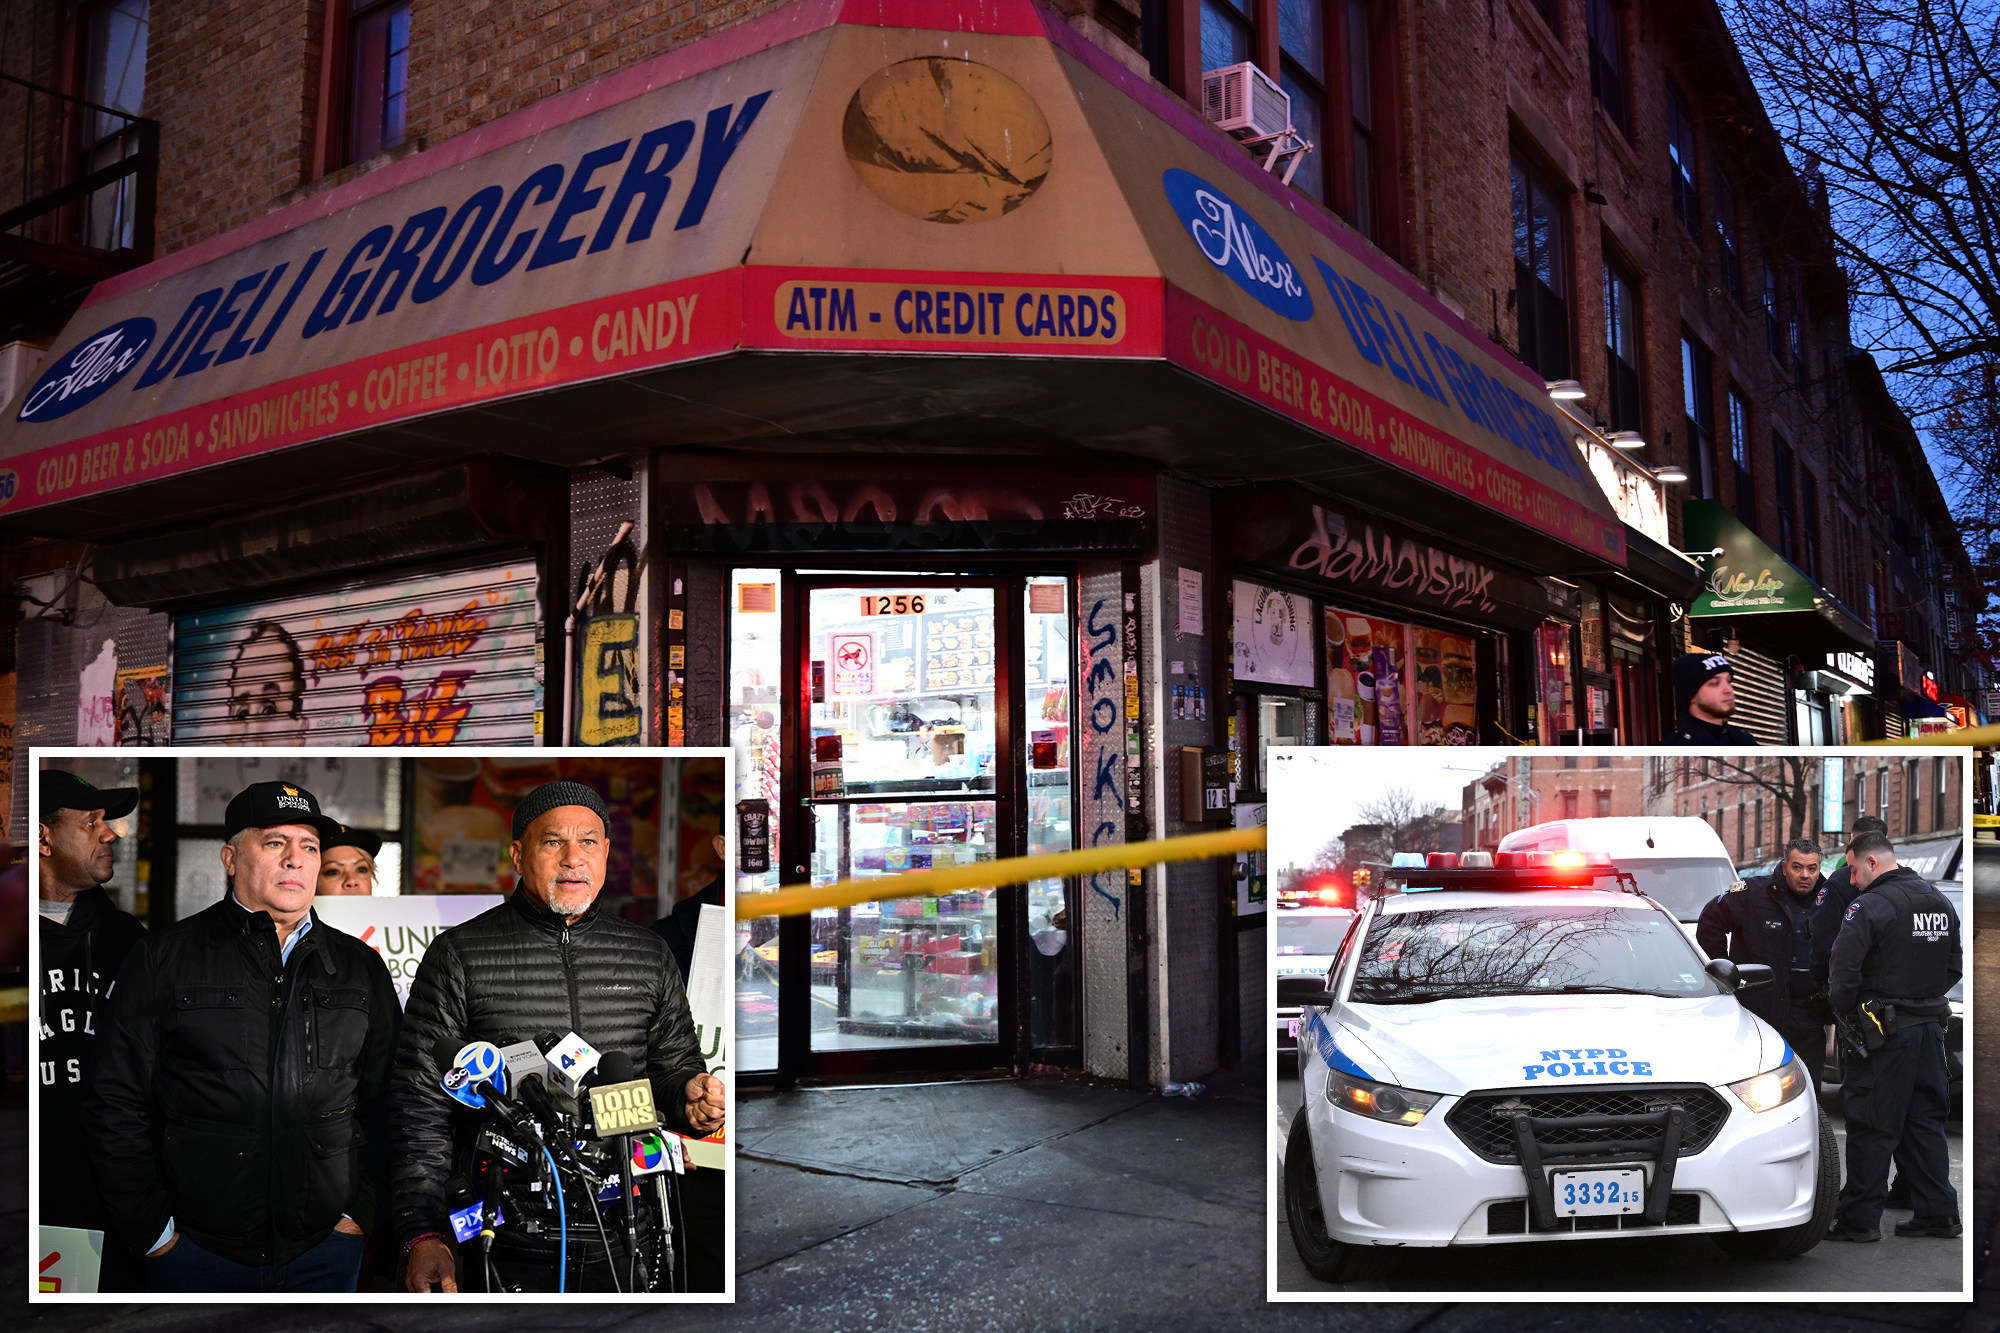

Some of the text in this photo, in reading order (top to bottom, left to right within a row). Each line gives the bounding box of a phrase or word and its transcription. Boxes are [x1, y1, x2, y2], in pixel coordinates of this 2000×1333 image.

[132, 89, 773, 392] DELI GROCERY
[1191, 189, 1302, 298] Alex
[786, 286, 857, 331] ATM
[894, 290, 1004, 335] CREDIT
[1015, 292, 1117, 339] CARDS
[1311, 254, 1450, 408] DELI
[20, 328, 147, 418] Alex
[36, 294, 699, 496] COLD BEER & SODA SANDWICHES COFFEE LOTTO CANDY
[1191, 315, 1251, 383] COLD
[1257, 348, 1304, 412] BEER
[1310, 377, 1323, 419] &
[1328, 386, 1375, 444] SODA
[1389, 417, 1475, 490] SANDWICHES
[1486, 467, 1523, 512] COFFEE
[1533, 489, 1560, 529] LOTTO
[865, 595, 924, 615] 1256
[276, 795, 309, 806] UNITED
[743, 813, 766, 822] CRAZY
[743, 837, 767, 846] COWBOY
[1913, 912, 1949, 931] NYPD
[507, 1052, 540, 1064] NEW YORK
[560, 1053, 576, 1070] 4
[1540, 1048, 1628, 1062] NYPD
[39, 1058, 81, 1086] US
[446, 1068, 469, 1088] abc
[1522, 1061, 1653, 1081] POLICE
[593, 1086, 651, 1115] 1010
[595, 1105, 655, 1131] WINS
[491, 1137, 518, 1157] NEWS
[1563, 1181, 1639, 1206] 3332 15
[453, 1208, 484, 1233] PIX
